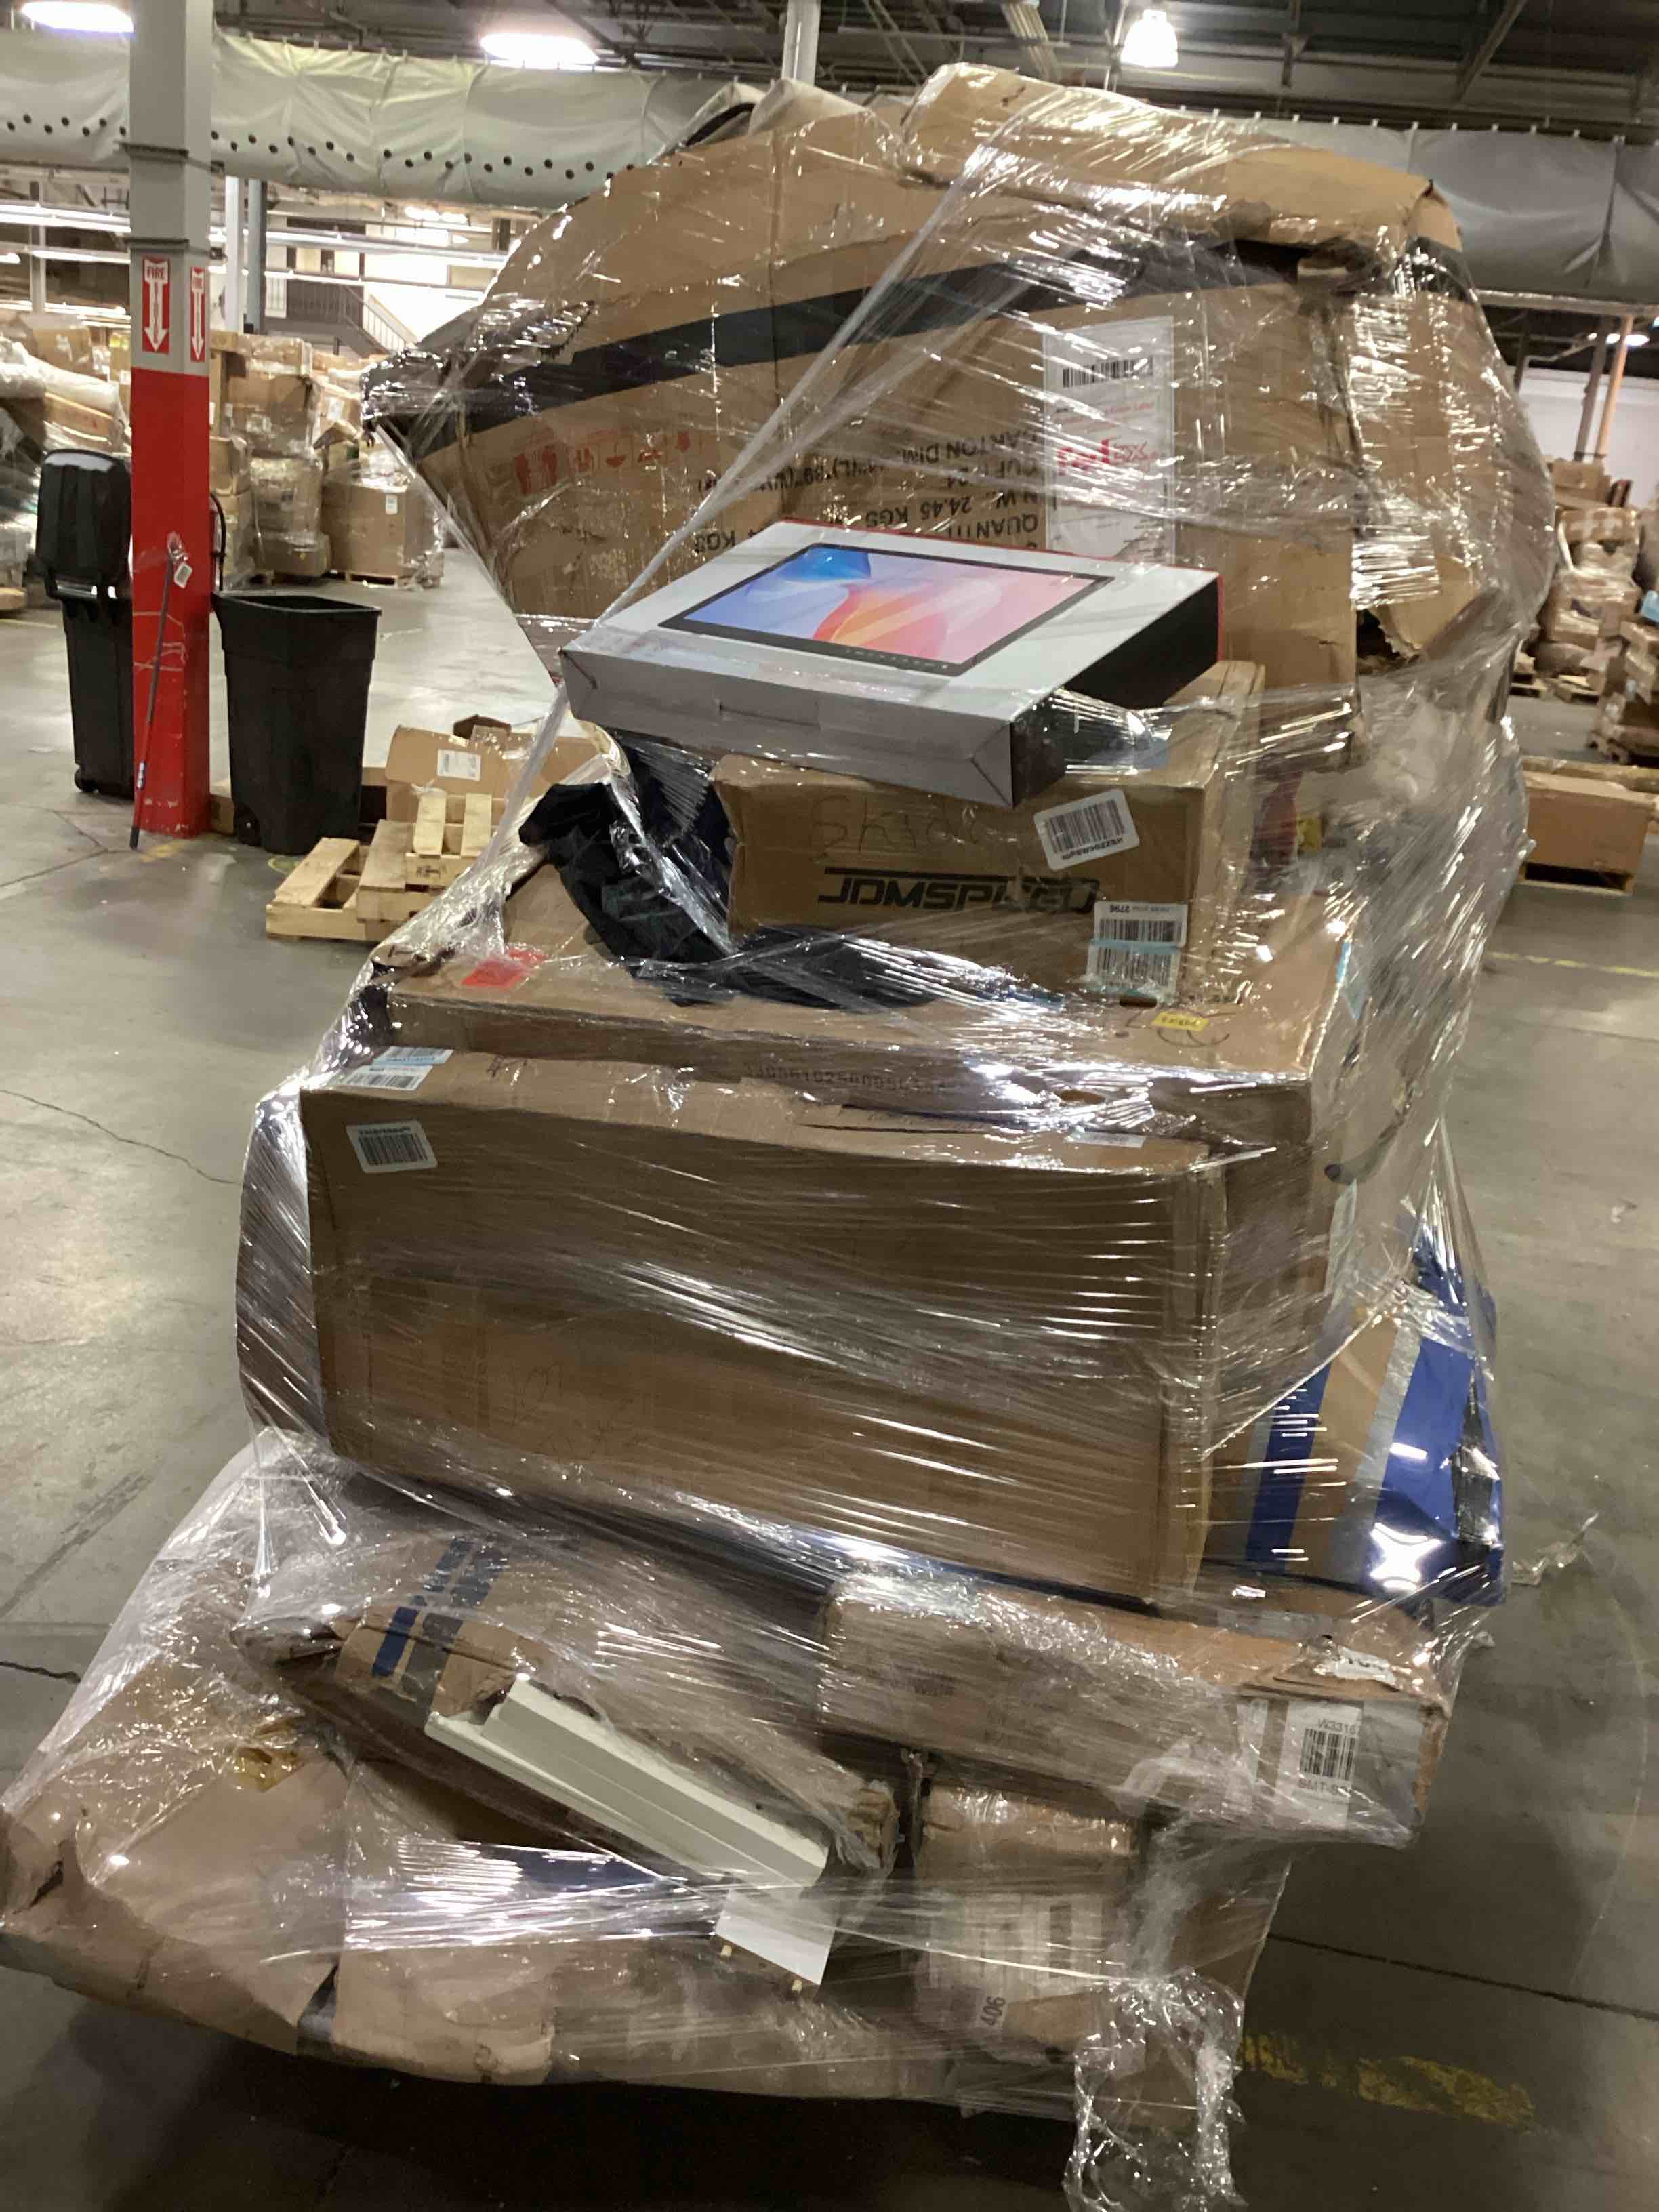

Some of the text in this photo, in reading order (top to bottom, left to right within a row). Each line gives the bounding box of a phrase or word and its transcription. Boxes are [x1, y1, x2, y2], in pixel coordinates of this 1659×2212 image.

[146, 266, 165, 280] FIRE
[866, 506, 909, 528] KGS
[920, 497, 972, 521] 24.45
[980, 1996, 1006, 2026] 406
